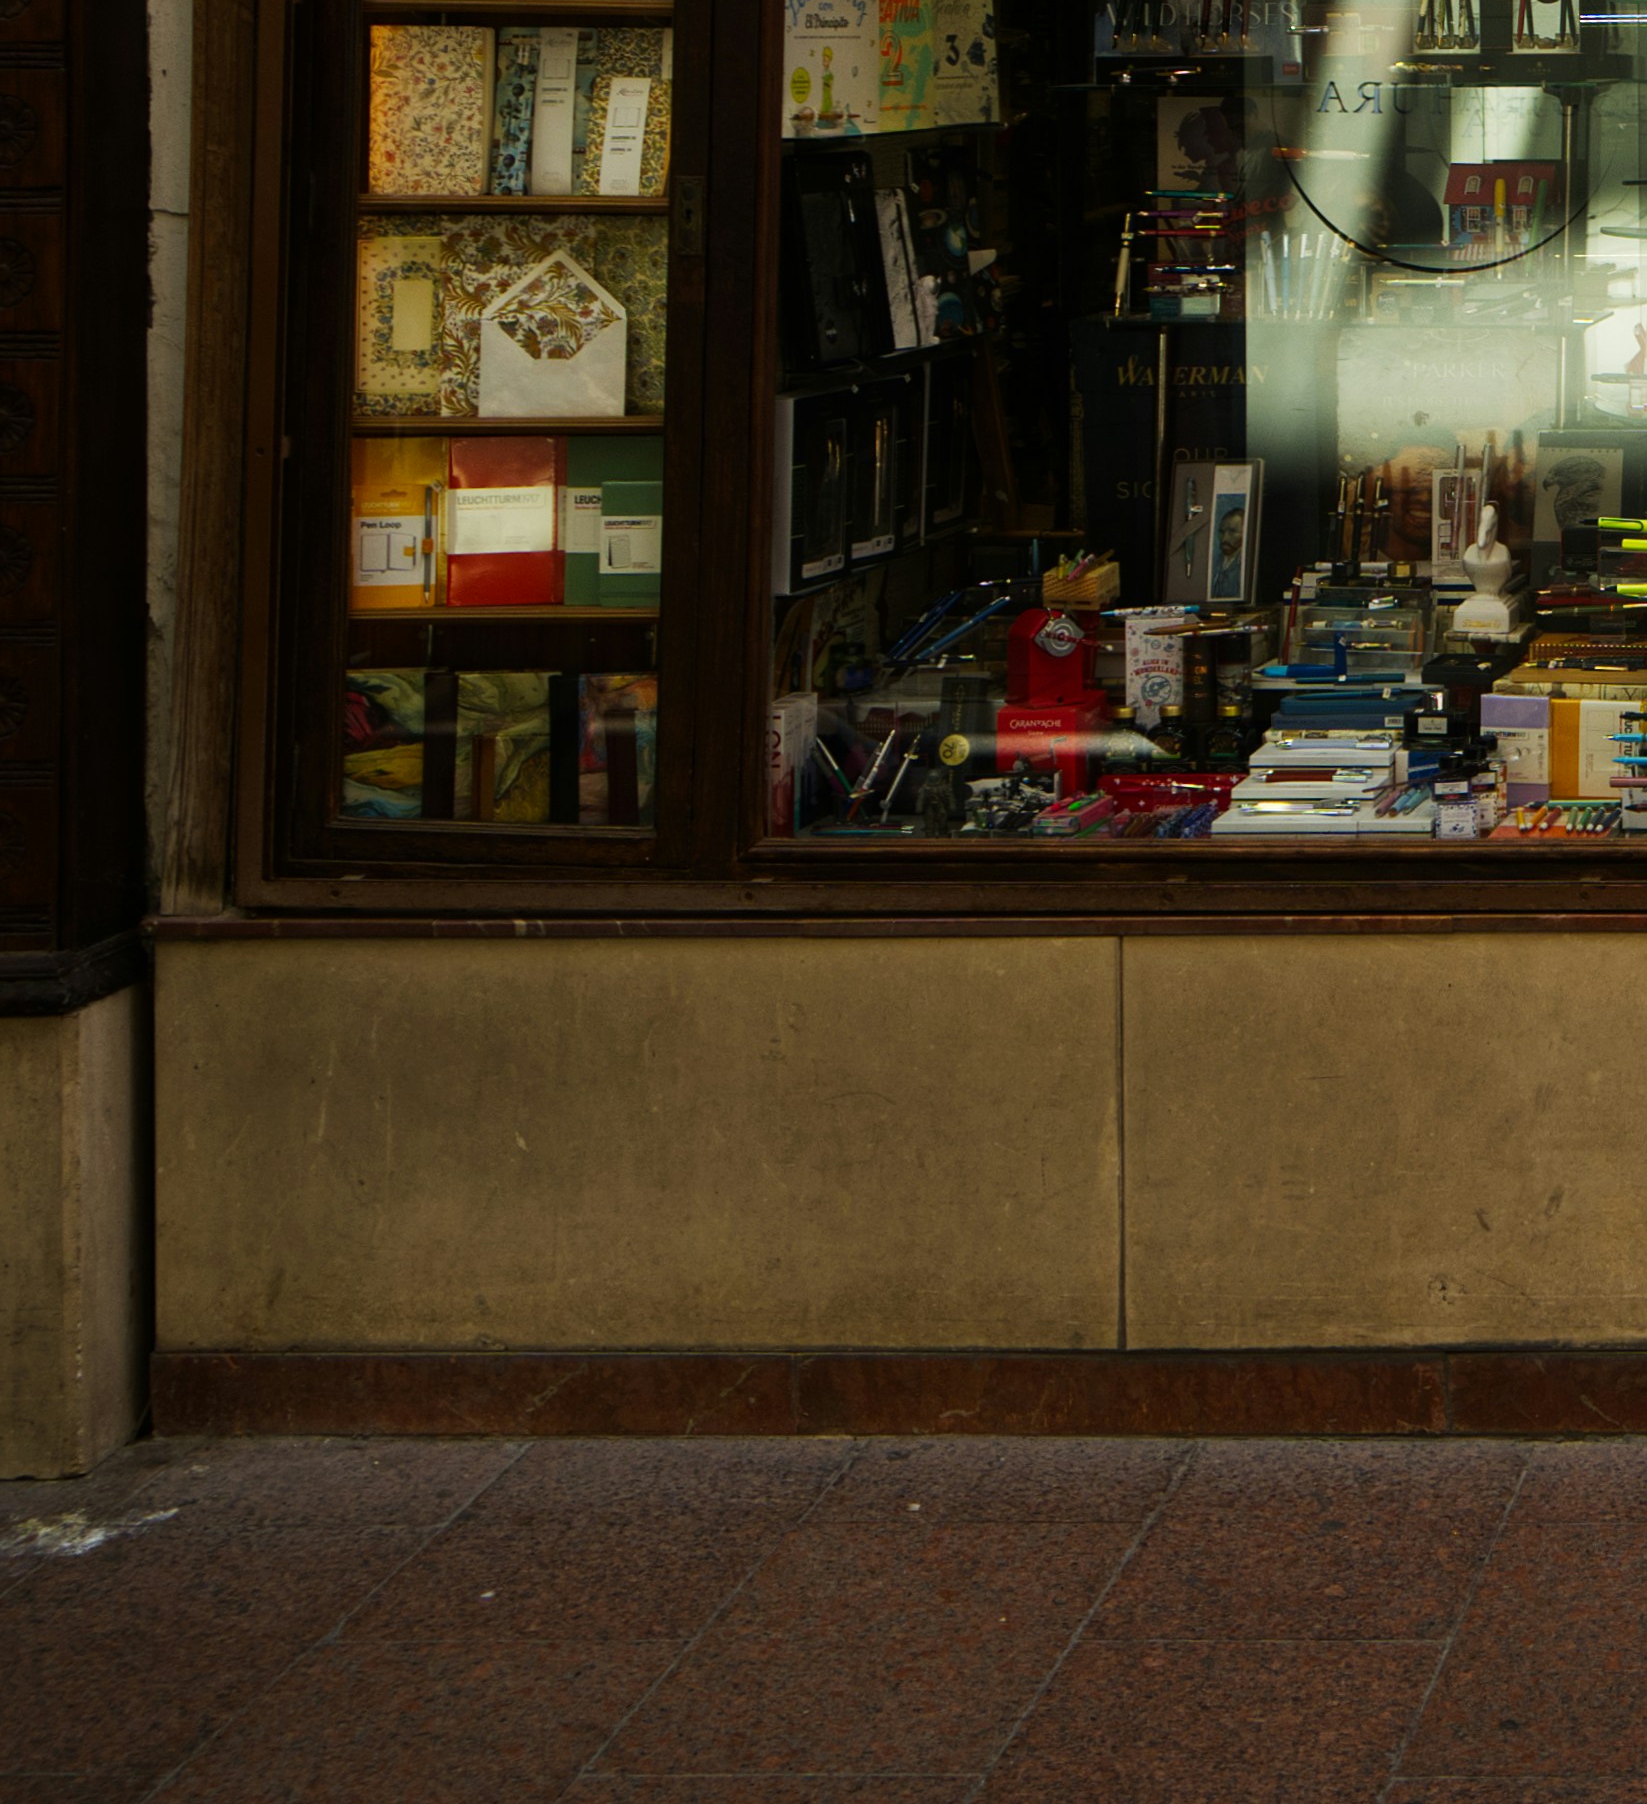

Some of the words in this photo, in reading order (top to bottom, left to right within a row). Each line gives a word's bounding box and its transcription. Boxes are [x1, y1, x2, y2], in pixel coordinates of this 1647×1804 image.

[818, 1, 834, 12] con
[1106, 1, 1177, 27] WILD
[1185, 1, 1298, 28] HORSES
[881, 30, 904, 86] 2
[945, 34, 960, 66] 3
[1116, 355, 1269, 386] WAERMAN
[1412, 361, 1505, 379] PARKER
[360, 520, 378, 530] Pen
[378, 520, 402, 531] Loop
